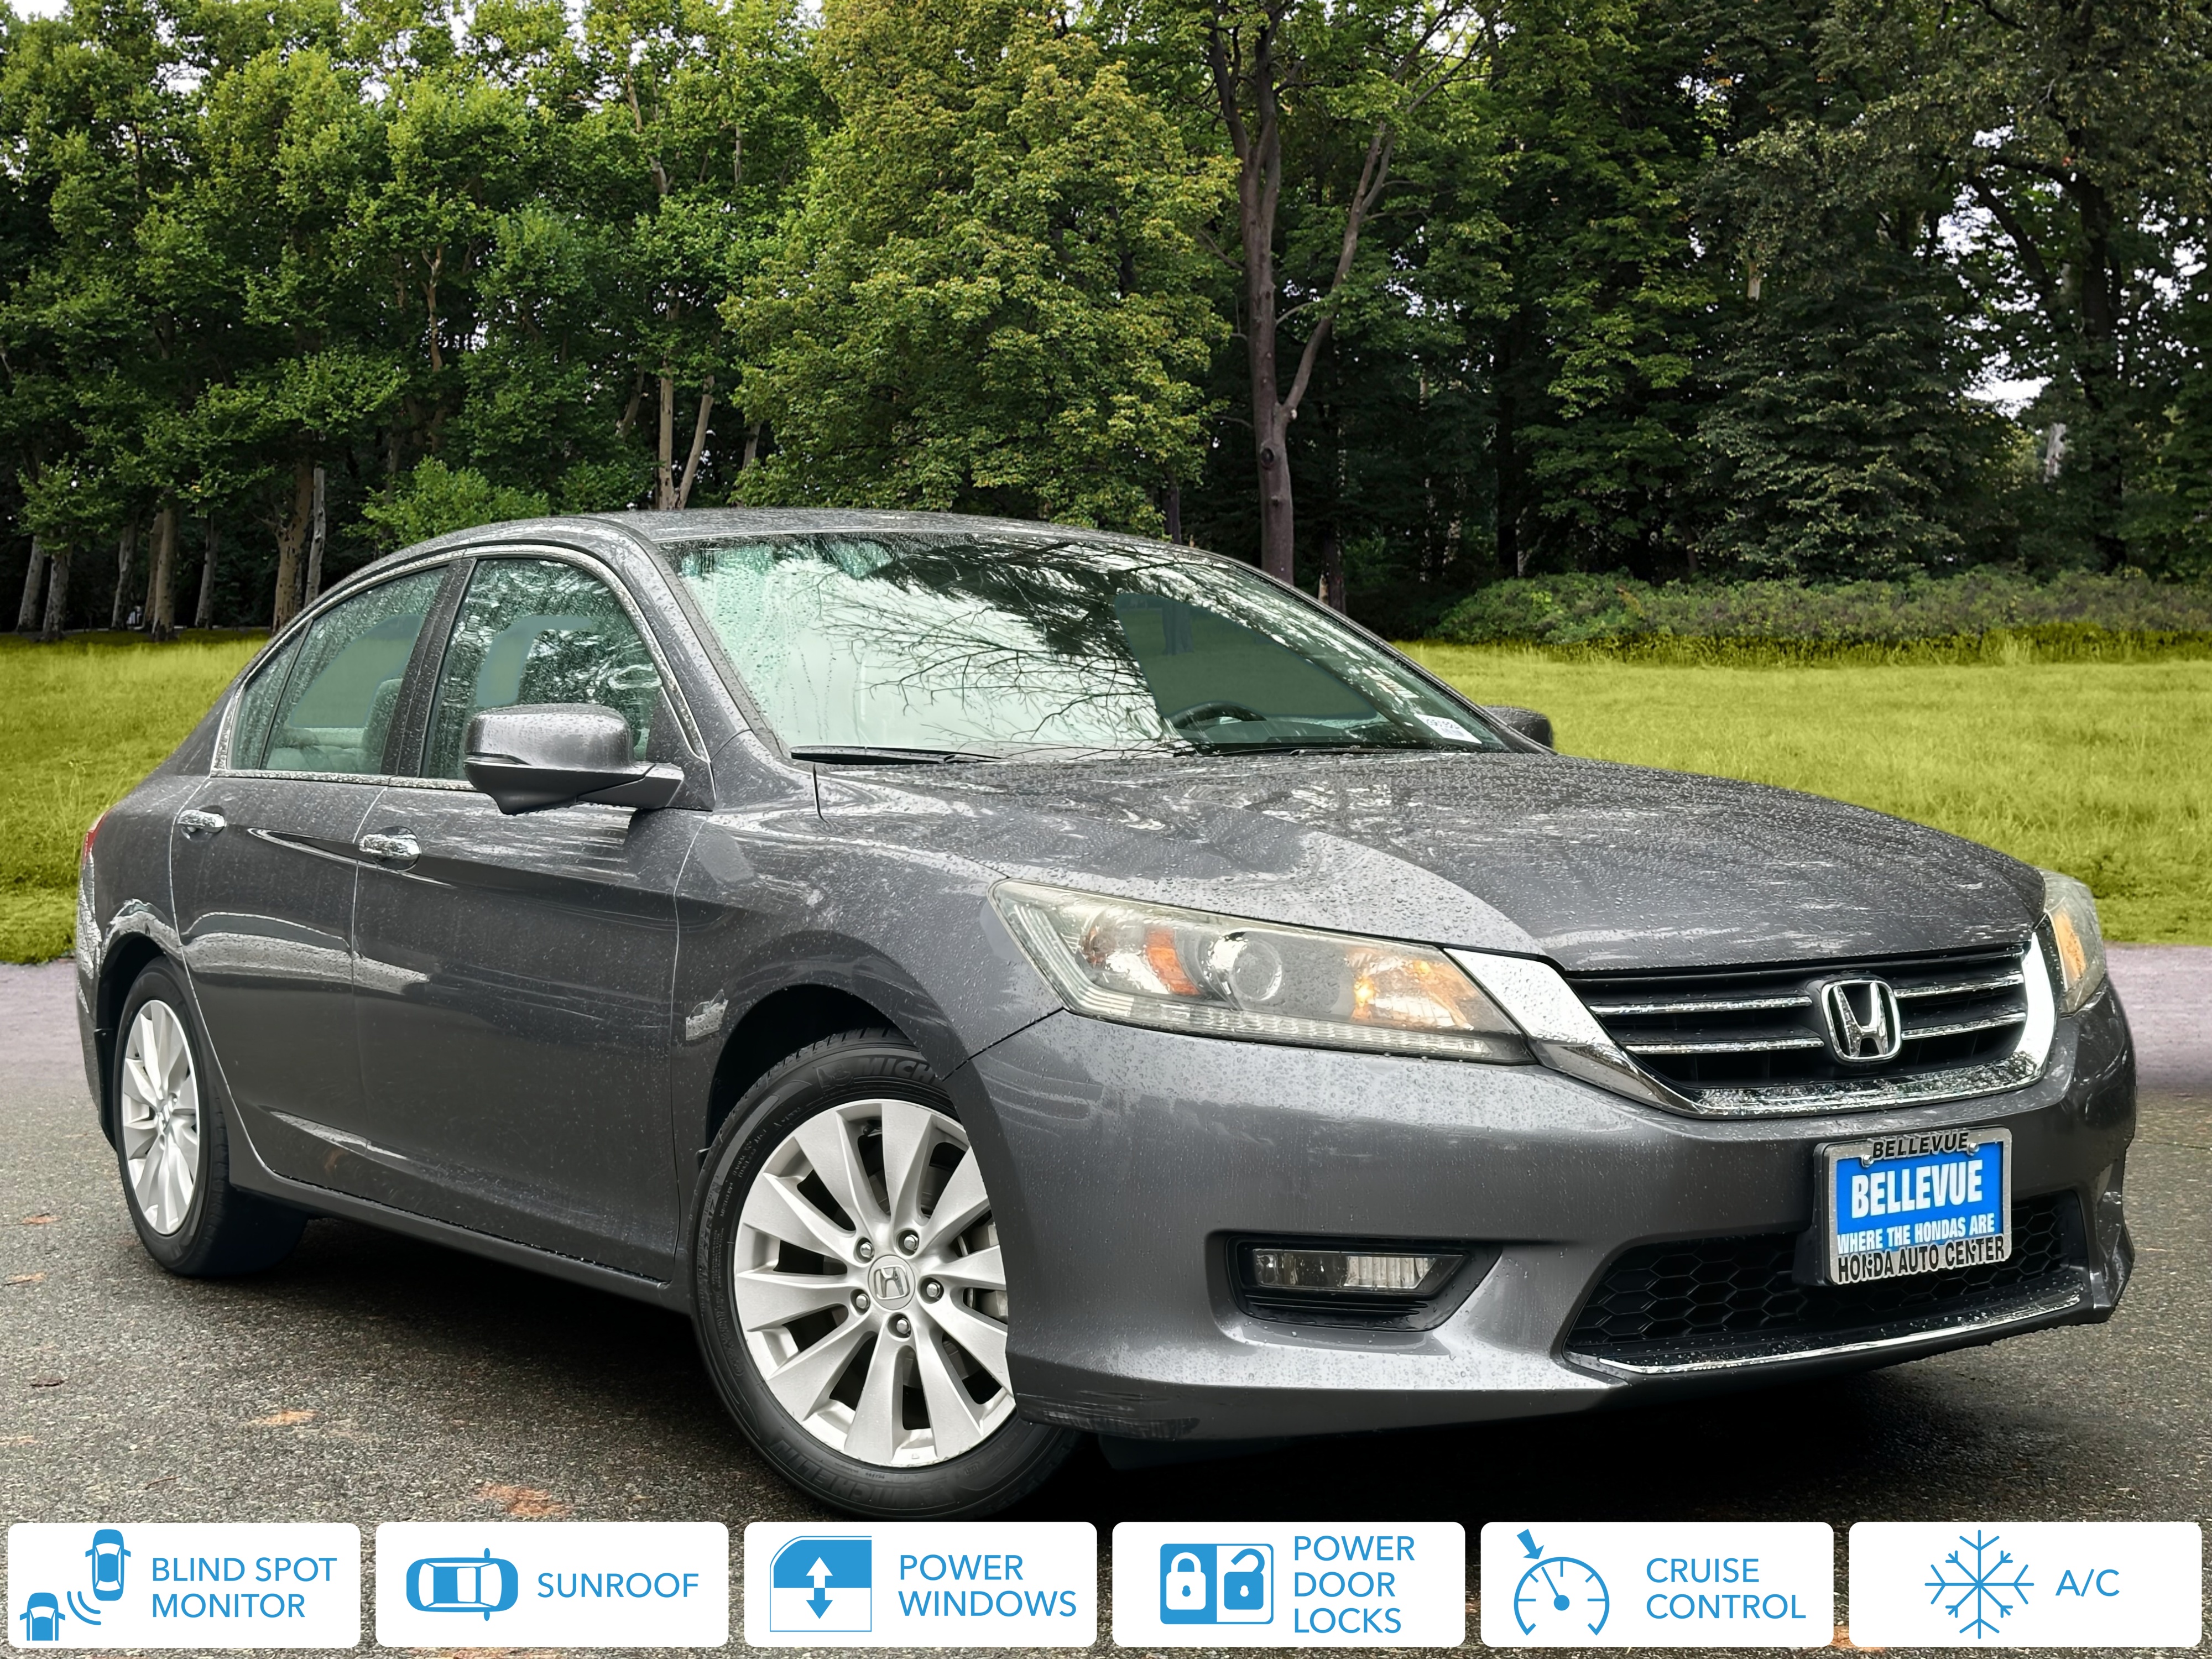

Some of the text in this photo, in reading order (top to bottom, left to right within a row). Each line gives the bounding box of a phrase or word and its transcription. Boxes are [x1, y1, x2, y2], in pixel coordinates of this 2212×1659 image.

[859, 1057, 936, 1082] MICH
[1872, 1132, 1969, 1159] BELLEVUE
[1851, 1159, 1983, 1219] BELLEVUE
[1837, 1213, 1995, 1254] WHERE THE HONDAS ARE
[1838, 1238, 2005, 1283] HONDA AUTO CENTER
